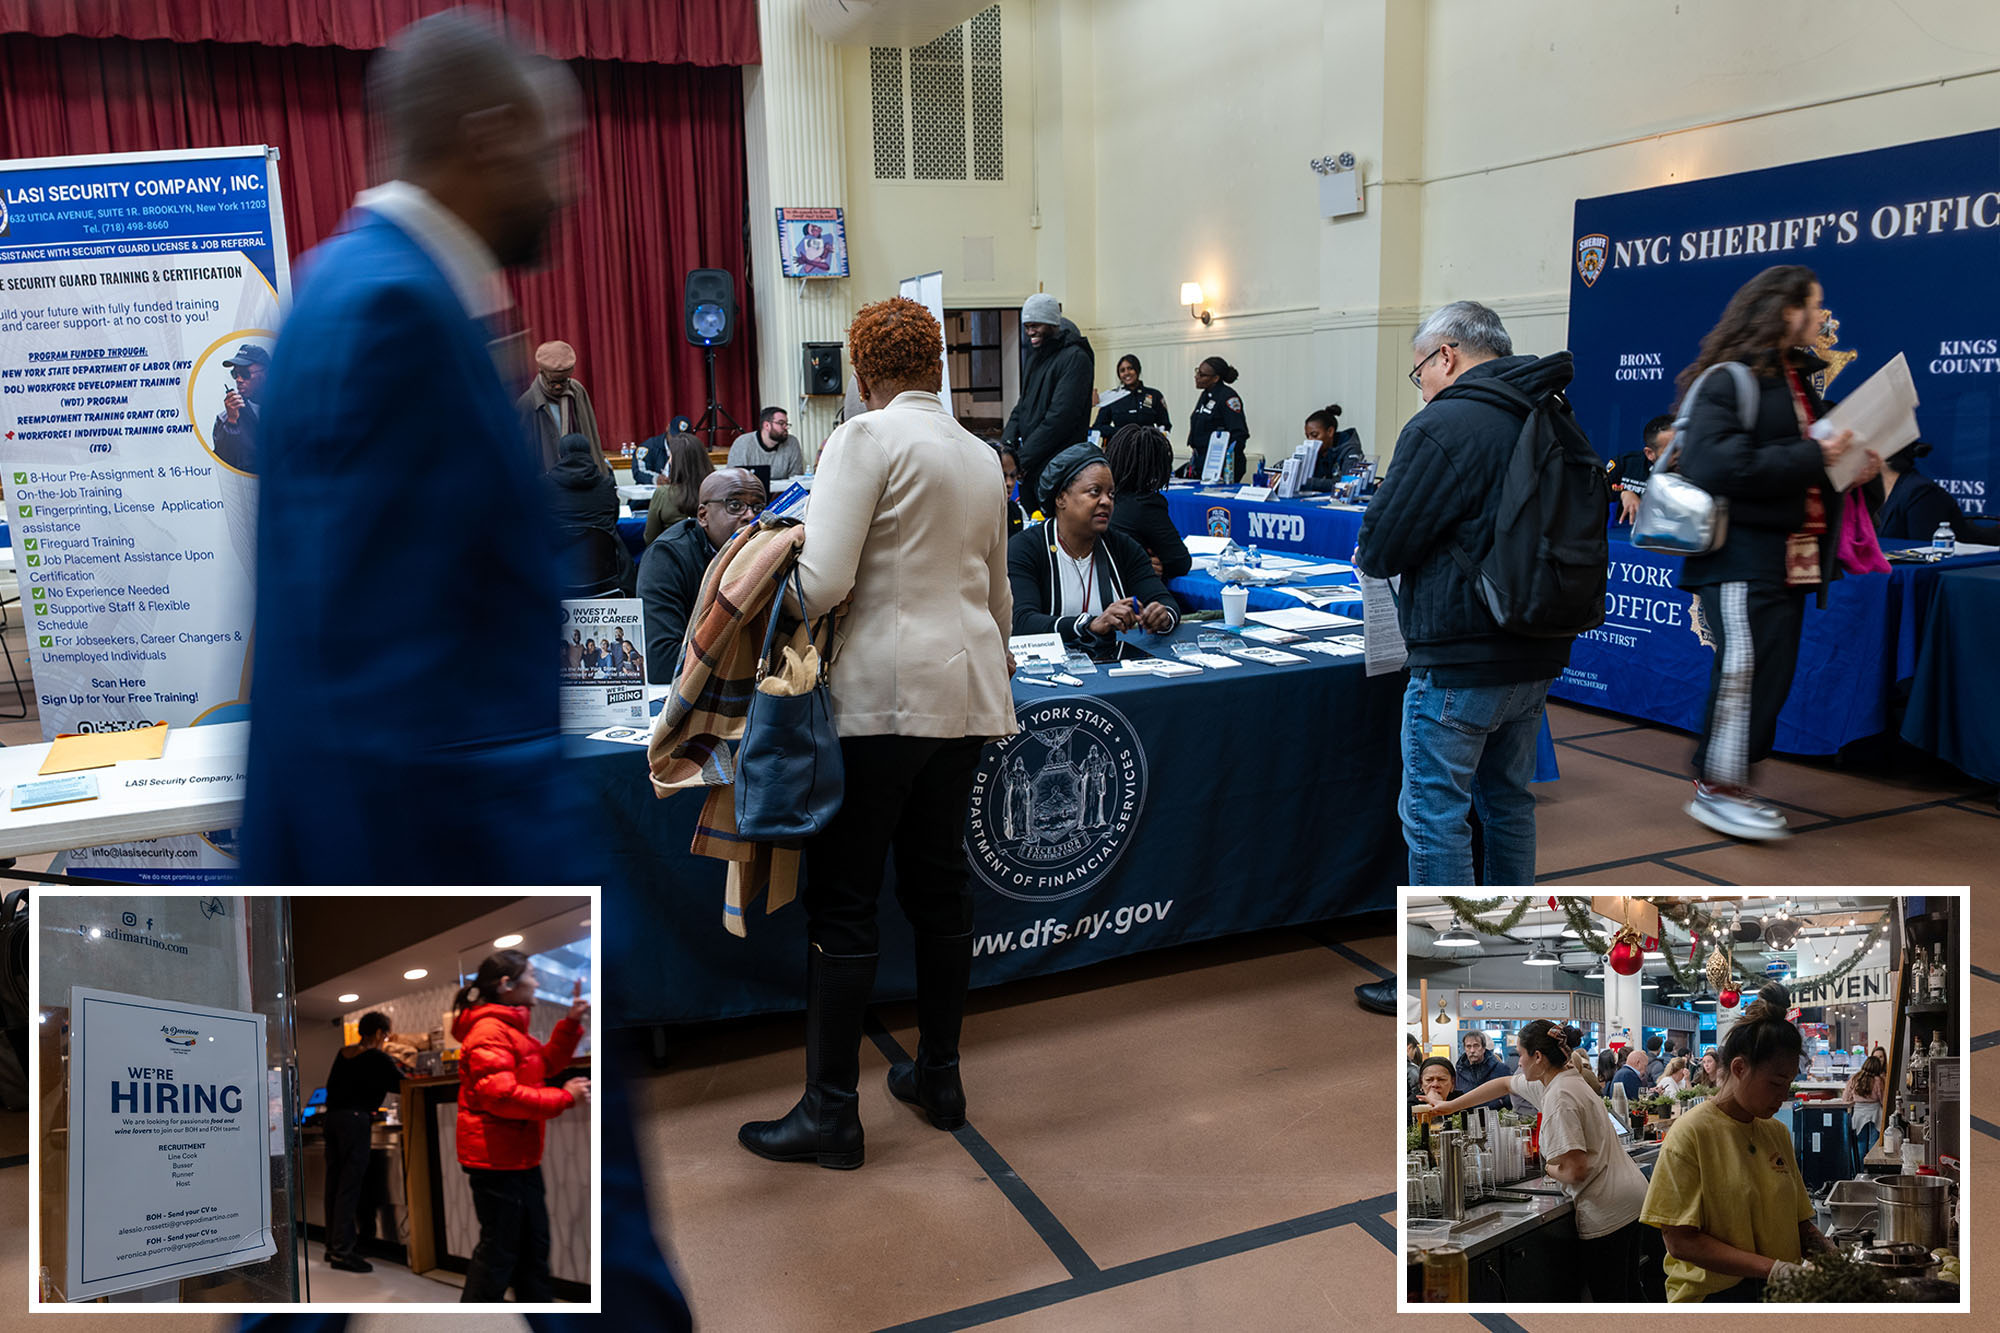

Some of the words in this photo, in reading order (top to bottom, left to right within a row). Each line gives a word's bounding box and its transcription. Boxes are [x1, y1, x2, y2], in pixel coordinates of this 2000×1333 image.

[7, 187, 45, 204] LASI
[49, 182, 130, 201] SECURITY
[135, 176, 227, 196] COMPANY,
[231, 175, 264, 190] INC.
[9, 214, 26, 223] 632
[28, 212, 55, 222] UTICA
[57, 210, 96, 220] AVENUE,
[98, 208, 124, 218] SUITE
[126, 207, 140, 216] 1R.
[142, 205, 195, 215] BROOKLYN,
[196, 204, 216, 212] New
[218, 201, 238, 212] York
[241, 200, 266, 210] 11203
[84, 225, 98, 234] Tel.
[102, 223, 124, 234] (718)
[127, 221, 168, 231] 498-8660
[1613, 236, 1671, 269] NYC
[1680, 210, 1858, 262] SHERIFF'S
[1870, 191, 2000, 240] OFFIC
[0, 251, 45, 261] SISTANCE
[48, 250, 70, 258] WITH
[72, 247, 115, 257] SECURITY
[118, 245, 150, 254] GUARD
[152, 242, 189, 252] LICENSE
[201, 240, 218, 249] JOB
[221, 238, 266, 248] REFERRAL
[8, 276, 56, 290] SECURITY
[60, 273, 97, 287] GUARD
[100, 271, 149, 285] TRAINING
[163, 266, 242, 281] CERTIFICATION
[21, 308, 45, 321] your
[48, 306, 78, 317] future
[82, 304, 105, 315] with
[108, 302, 130, 316] fully
[133, 301, 173, 312] funded
[176, 299, 219, 313] training
[2, 321, 23, 332] and
[26, 320, 60, 330] career
[63, 316, 110, 330] support-
[113, 317, 123, 325] at
[127, 316, 141, 325] no
[144, 314, 168, 325] cost
[170, 314, 182, 323] to
[185, 312, 209, 324] you!
[28, 351, 67, 361] PROGRAM
[70, 349, 105, 359] FUNDED
[107, 347, 148, 357] THROUGH:
[1940, 339, 1997, 356] KINGS
[1619, 353, 1661, 366] BRONX
[2, 369, 22, 378] NEW
[25, 367, 46, 377] YORK
[49, 366, 70, 376] STATE
[72, 364, 127, 374] DEPARTMENT
[129, 363, 140, 372] OF
[142, 362, 170, 371] LABOR
[173, 360, 192, 371] (NYS
[1615, 367, 1664, 381] COUNTY
[4, 384, 25, 394] DOL)
[27, 382, 75, 393] WORKFORCE
[78, 380, 138, 390] DEVELOPMENT
[140, 377, 180, 387] TRAINING
[60, 397, 84, 408] (WDT)
[87, 396, 128, 405] PROGRAM
[18, 413, 82, 425] REEMPLOYMENT
[84, 412, 125, 422] TRAINING
[127, 411, 154, 420] GRANT
[156, 409, 179, 419] (RTG)
[18, 429, 72, 440] WORKFORCE1
[74, 427, 122, 438] INDIVIDUAL
[124, 426, 164, 435] TRAINING
[166, 424, 194, 433] GRANT
[89, 443, 111, 454] (ITG)
[30, 472, 67, 483] 8-Hour
[70, 469, 154, 482] Pre-Assignment
[169, 466, 212, 476] 16-Hour
[17, 487, 77, 500] On-the-Job
[79, 487, 123, 499] Training
[1933, 479, 1985, 496] EENS
[35, 503, 111, 517] Fingerprinting,
[114, 502, 155, 513] License
[161, 500, 224, 513] Application
[22, 523, 81, 533] assistance
[1248, 512, 1305, 542] NYPD
[40, 539, 90, 551] Fireguard
[92, 536, 135, 549] Training
[43, 555, 62, 566] Job
[64, 553, 120, 565] Placement
[124, 552, 182, 562] Assistance
[185, 551, 214, 563] Upon
[30, 571, 95, 583] Certification
[1620, 563, 1673, 588] YORK
[48, 588, 63, 598] No
[66, 587, 124, 599] Experience
[128, 585, 169, 595] Needed
[50, 603, 105, 616] Supportive
[109, 601, 135, 612] Staff
[149, 600, 190, 611] Flexible
[37, 620, 88, 631] Schedule
[55, 635, 73, 646] For
[75, 633, 138, 646] Jobseekers,
[141, 634, 175, 643] Career
[179, 632, 231, 644] Changers
[1610, 632, 1637, 648] FIRST
[42, 651, 109, 663] Unemployed
[111, 650, 166, 661] Individuals
[91, 679, 117, 688] Scan
[120, 678, 146, 687] Here
[42, 695, 68, 706] Sign
[70, 695, 84, 706] Up
[86, 694, 100, 704] for
[102, 694, 126, 703] Your
[128, 694, 152, 703] Free
[154, 692, 199, 704] Training!
[610, 692, 640, 702] HIRING
[1030, 707, 1070, 725] YORK
[1075, 708, 1115, 736] STATE
[150, 778, 187, 787] Security
[189, 775, 234, 785] Company,
[971, 773, 1010, 877] DEPARTMENT
[1013, 873, 1033, 887] OF
[1039, 838, 1118, 887] FINANCIAL
[1116, 750, 1135, 832] SERVICES
[92, 848, 198, 859] info@lasisecurity.com
[1530, 1002, 1567, 1010] GRUB
[128, 1066, 173, 1080] WE'RE
[112, 1081, 242, 1114] HIRING
[159, 1143, 206, 1151] RECRUITMENT
[146, 1213, 162, 1221] BOH
[168, 1210, 184, 1218] Send
[185, 1209, 200, 1217] your
